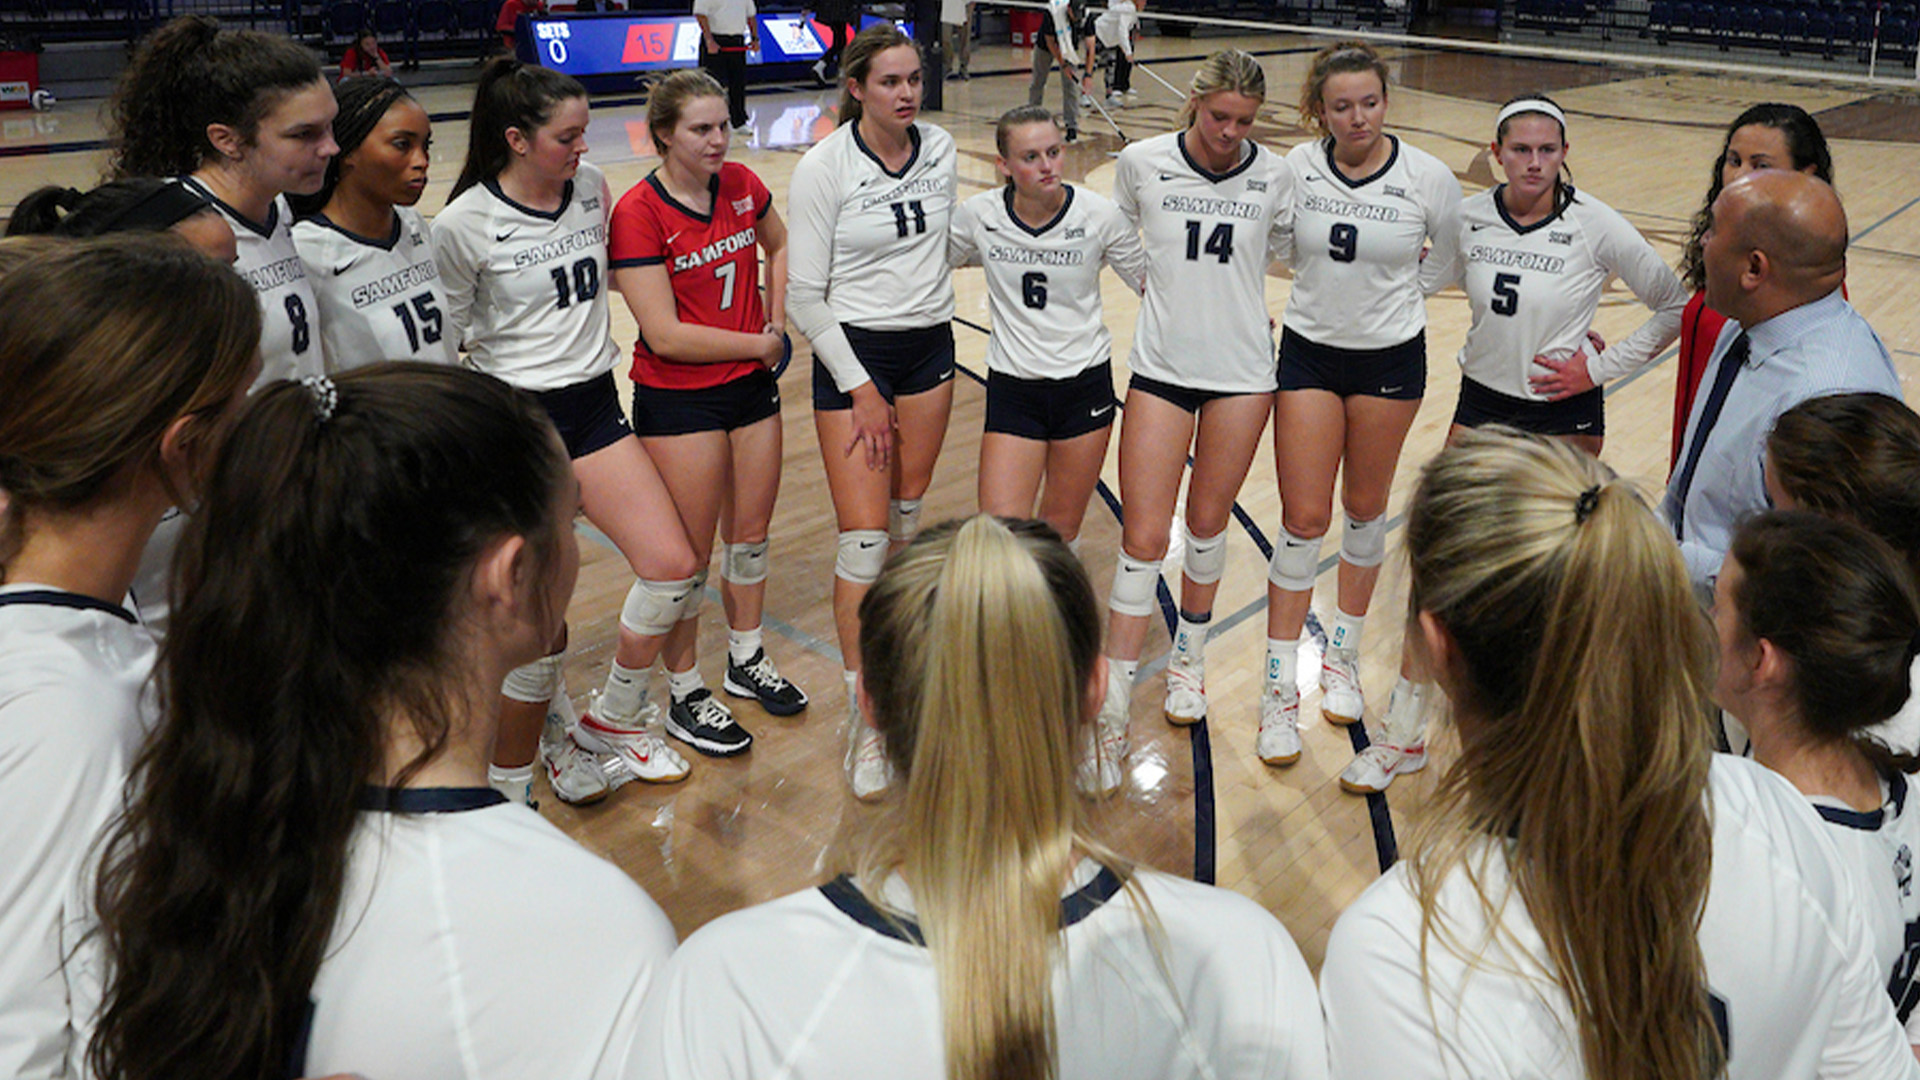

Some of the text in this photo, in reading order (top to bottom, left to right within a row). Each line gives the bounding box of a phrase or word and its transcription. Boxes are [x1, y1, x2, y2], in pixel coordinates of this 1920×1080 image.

[536, 22, 570, 39] SETS
[636, 32, 665, 55] 15
[549, 39, 567, 64] 0
[890, 200, 926, 239] 11
[1161, 194, 1262, 220] SAMFORD
[1305, 194, 1398, 222] SAMFORD
[513, 223, 605, 270] SAMFORD
[674, 227, 756, 273] SAMFORD
[988, 244, 1084, 266] SAMFORD
[1185, 219, 1234, 264] 14
[1328, 222, 1358, 264] 9
[1468, 245, 1565, 274] SAMFORD
[242, 255, 306, 292] AMFOR
[550, 256, 600, 310] 10
[714, 259, 736, 311] 7
[1021, 270, 1049, 311] 6
[1490, 272, 1522, 318] 5
[284, 293, 311, 356] 8
[391, 290, 443, 353] 15
